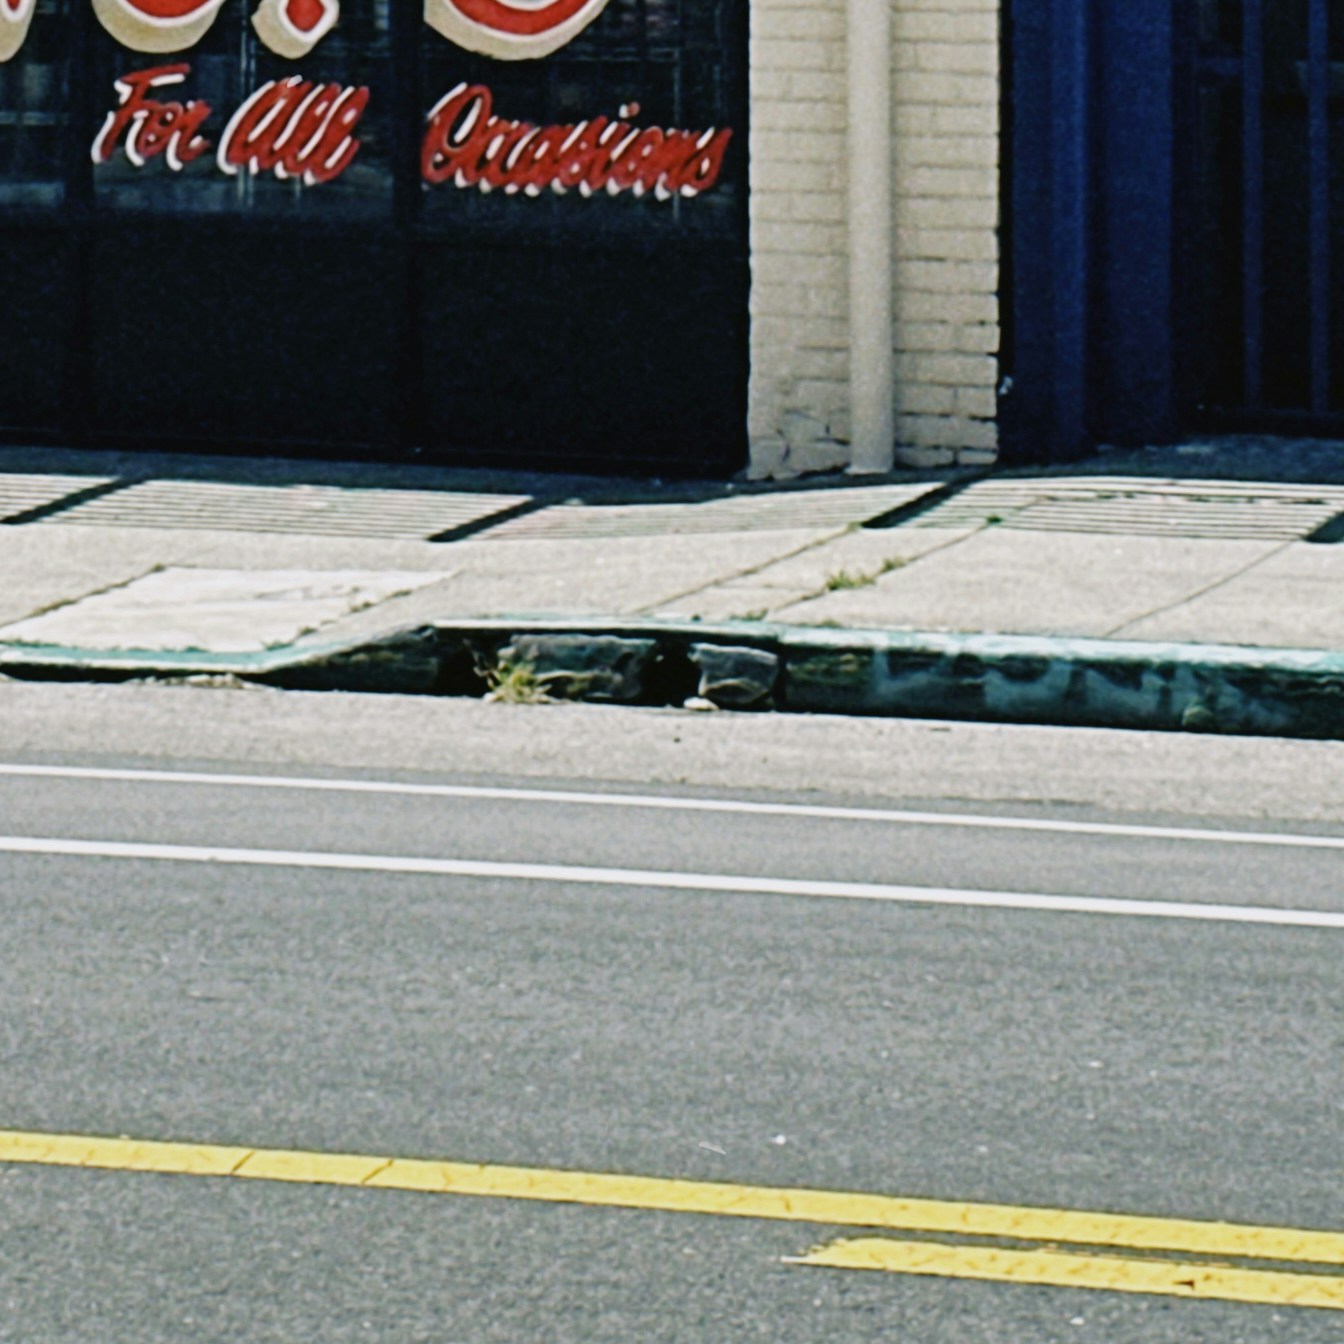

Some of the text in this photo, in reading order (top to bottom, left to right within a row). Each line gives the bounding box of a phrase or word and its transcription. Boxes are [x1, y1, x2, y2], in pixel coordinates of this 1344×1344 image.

[91, 62, 732, 200] For All Occasions
